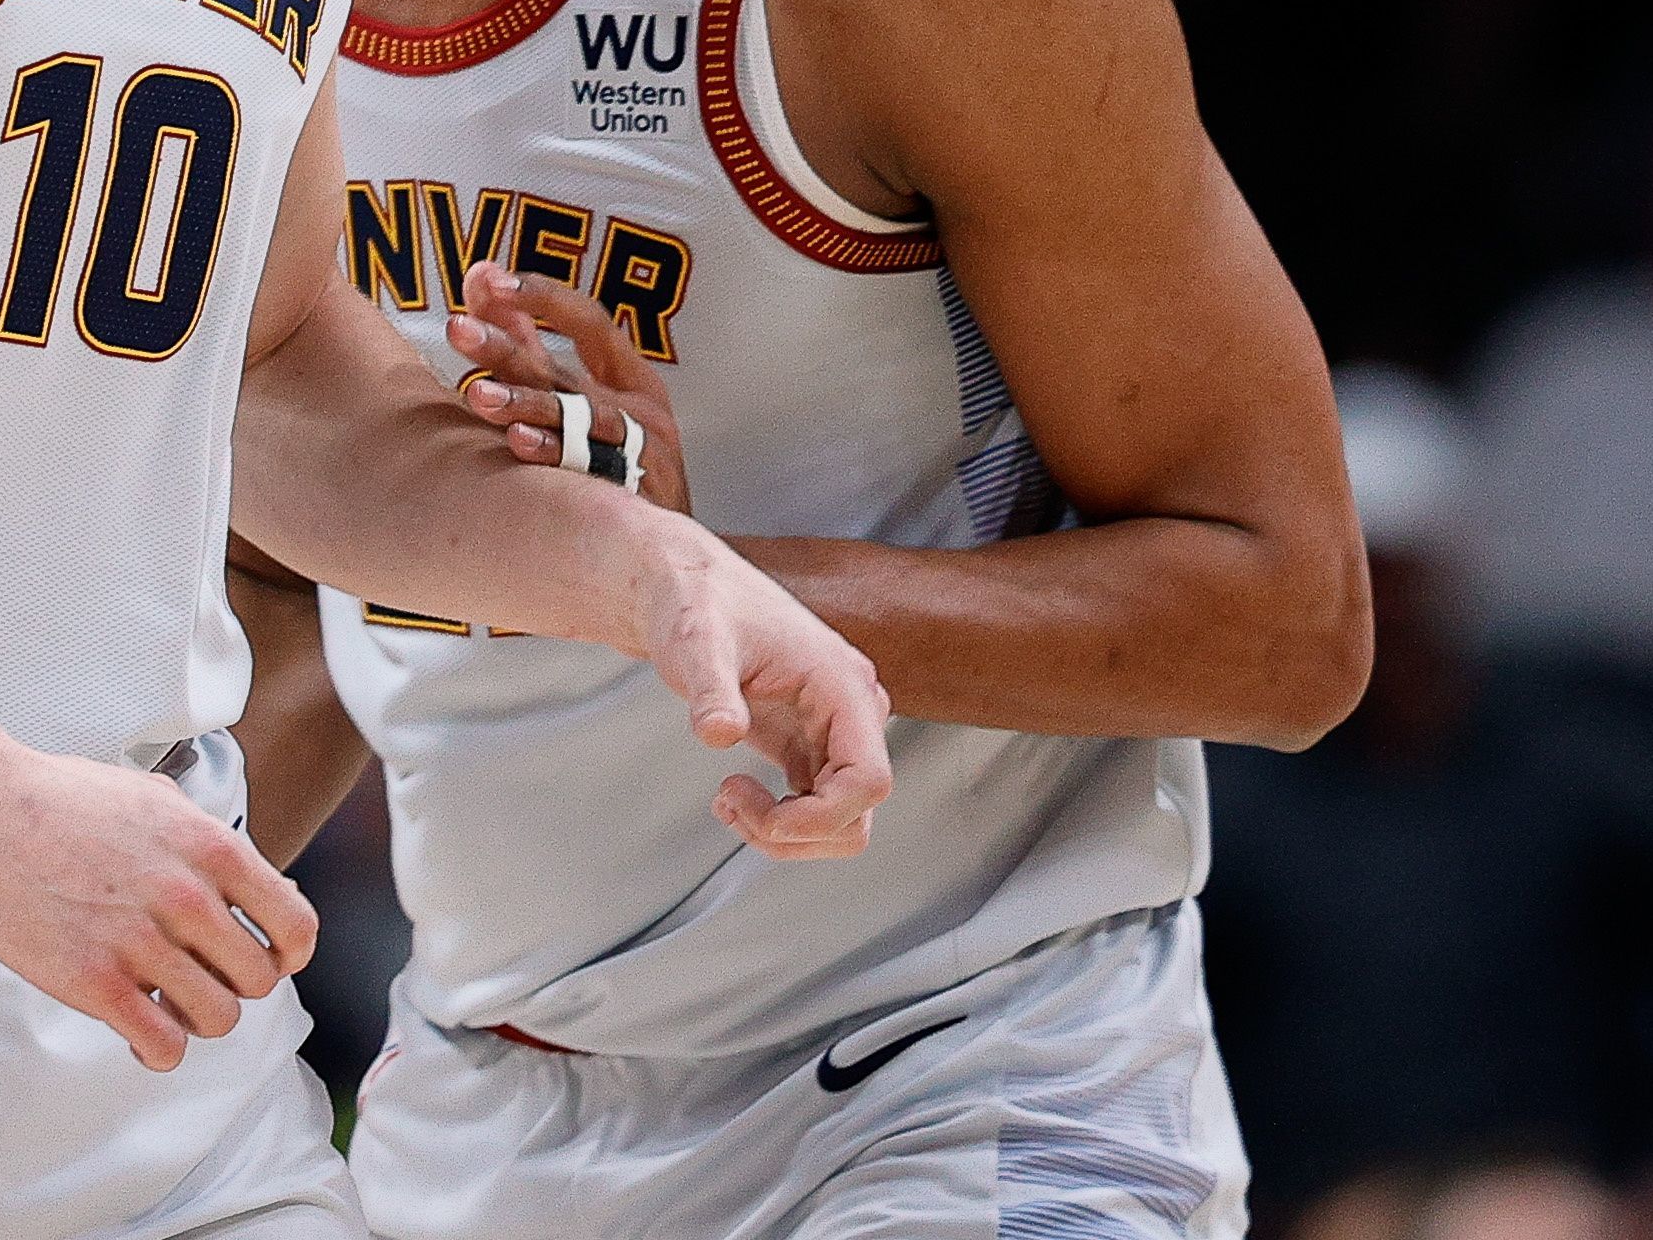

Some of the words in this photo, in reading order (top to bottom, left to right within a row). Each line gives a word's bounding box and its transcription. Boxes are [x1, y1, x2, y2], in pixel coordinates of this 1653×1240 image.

[575, 13, 688, 72] WU
[572, 79, 686, 108] Western
[590, 106, 669, 134] Union
